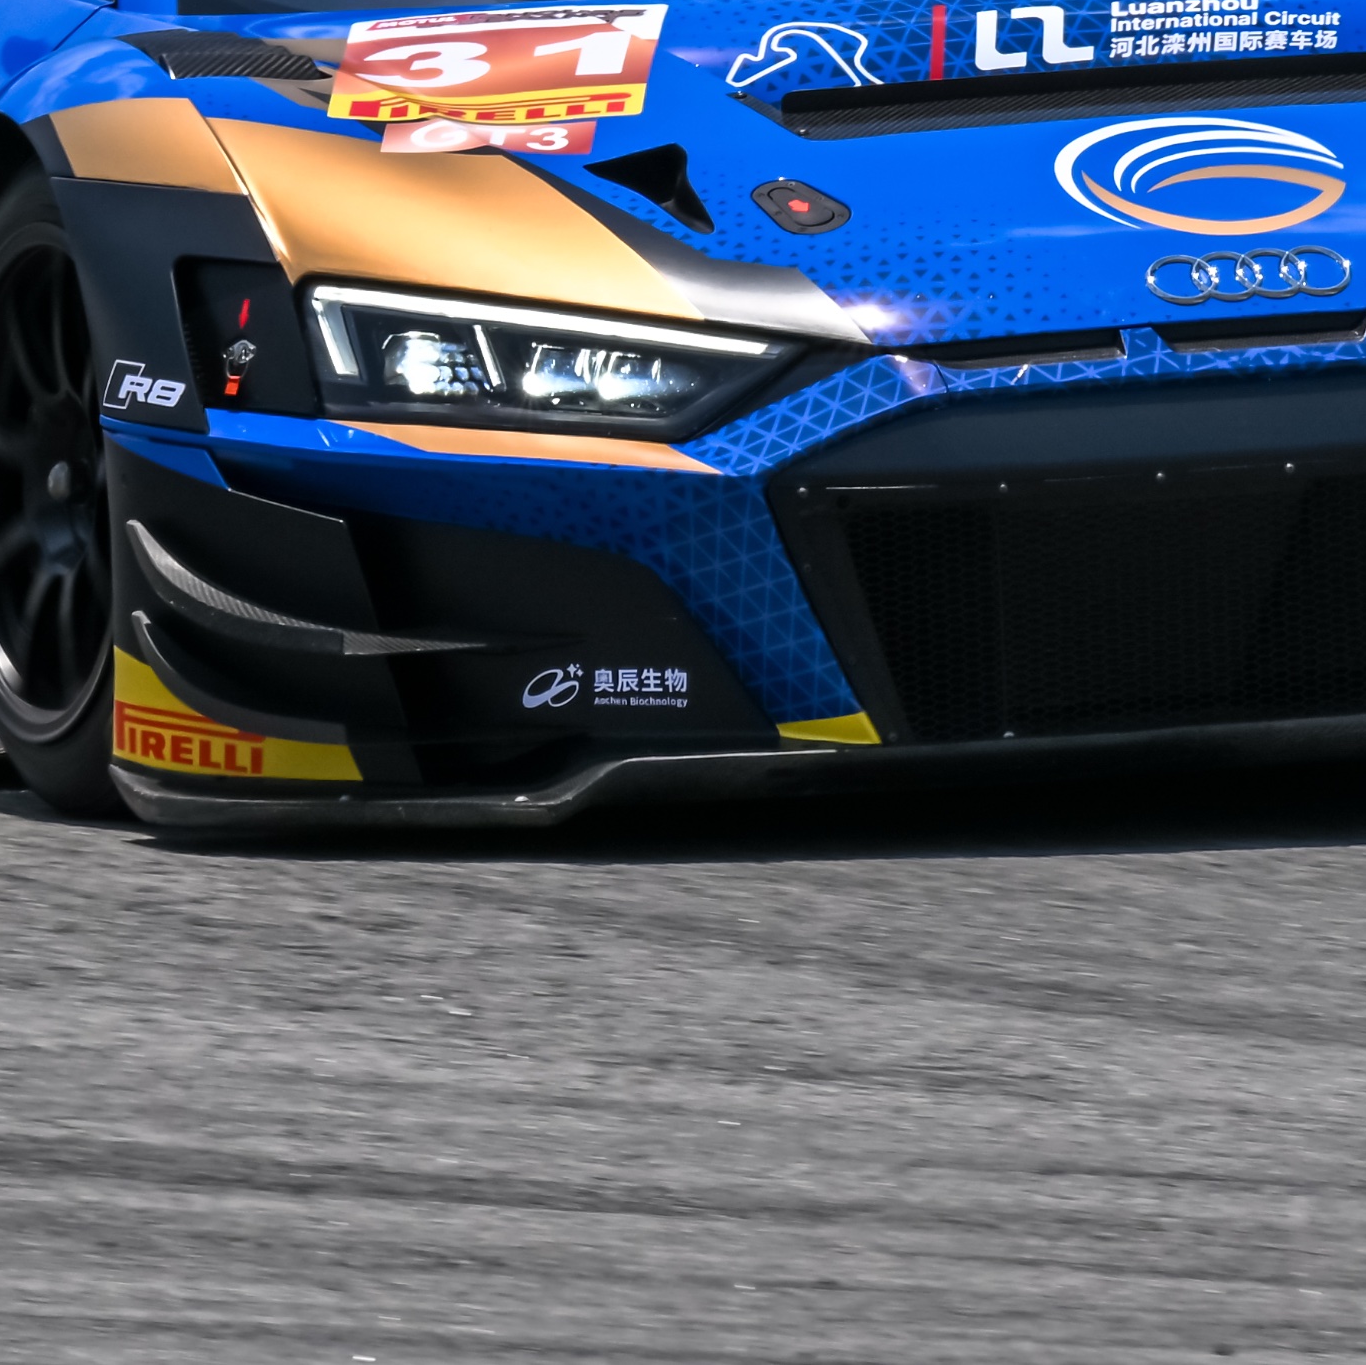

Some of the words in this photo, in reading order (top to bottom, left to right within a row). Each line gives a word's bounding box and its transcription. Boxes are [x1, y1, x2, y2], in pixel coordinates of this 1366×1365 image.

[376, 15, 458, 29] MOTUL
[1110, 12, 1258, 33] International
[1264, 10, 1341, 27] Circuit
[1109, 30, 1338, 59] 河北滦州国际赛车场
[354, 32, 634, 88] 31
[348, 92, 632, 122] PIRELLI
[410, 120, 570, 151] GT3
[118, 374, 186, 407] R8
[593, 668, 688, 693] 奥辰生物
[113, 700, 266, 775] PIRELLI
